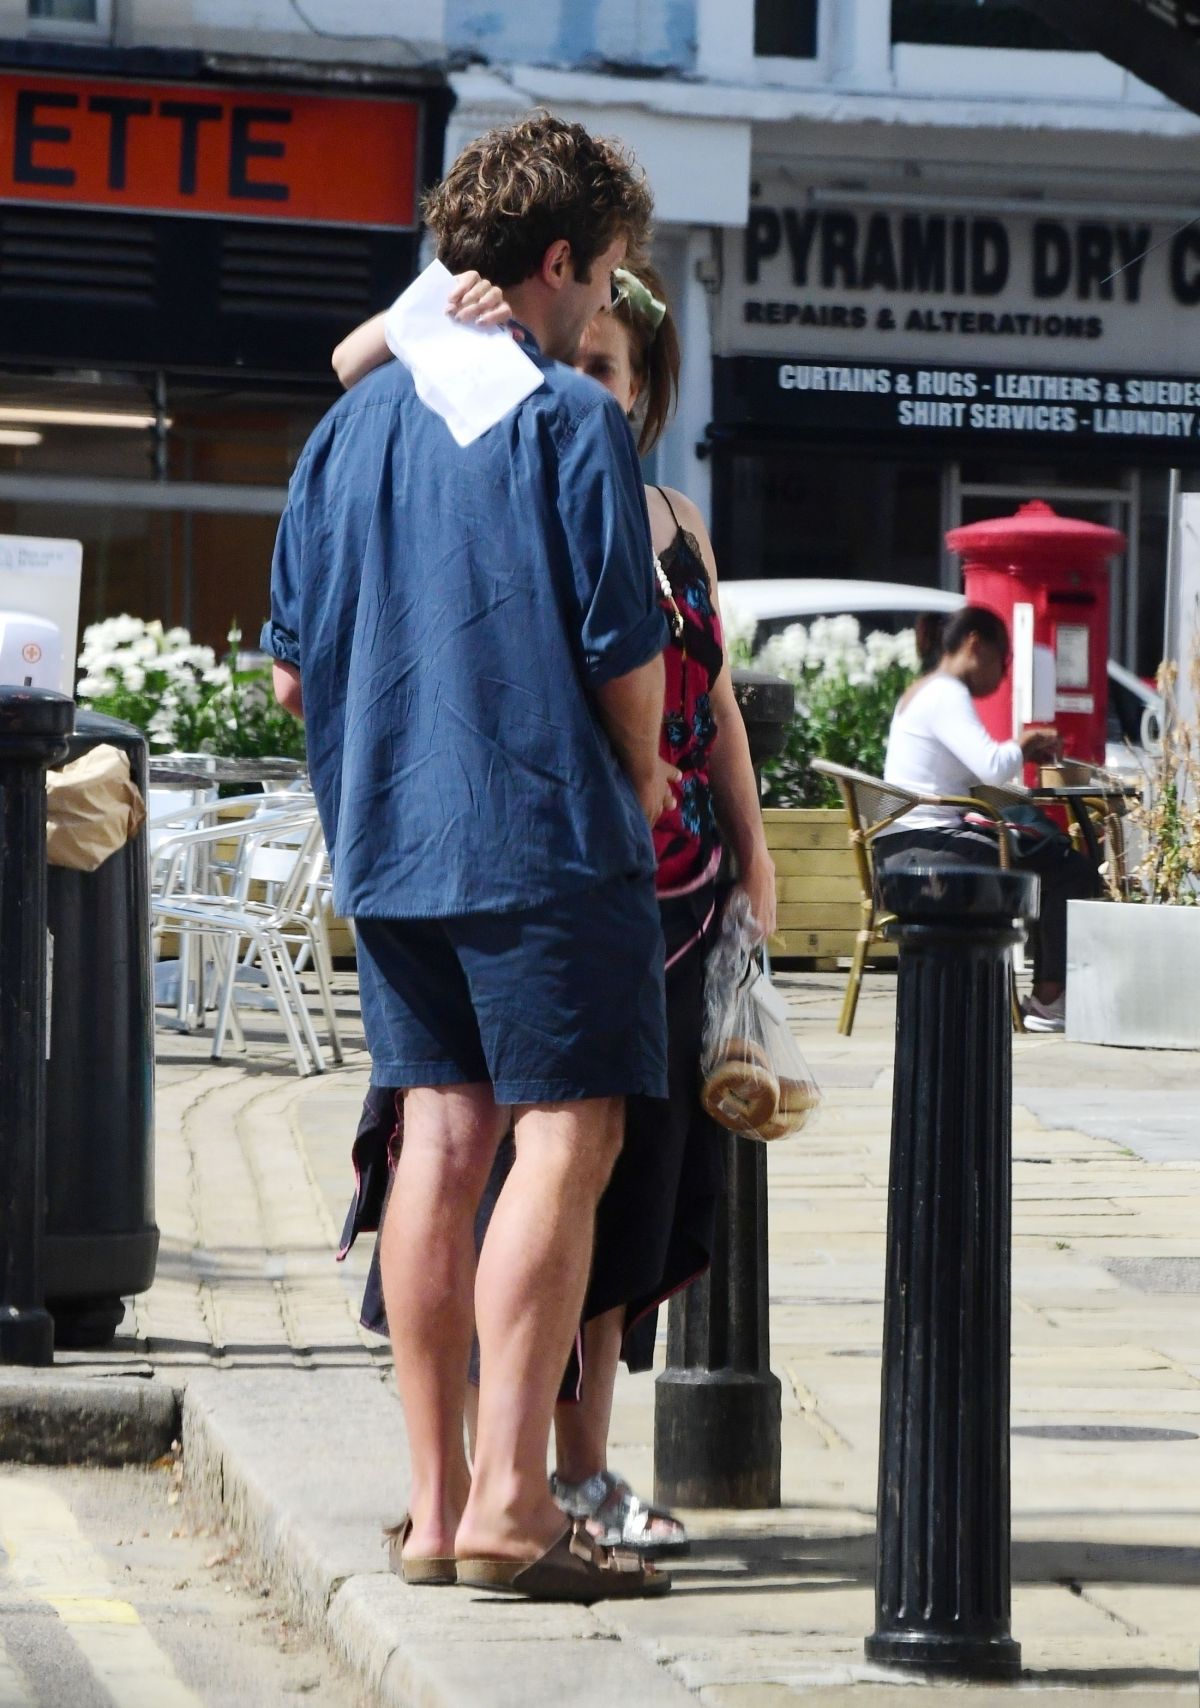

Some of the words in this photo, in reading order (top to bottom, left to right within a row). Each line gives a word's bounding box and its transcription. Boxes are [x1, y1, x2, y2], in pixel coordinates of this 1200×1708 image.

[13, 91, 293, 200] ETTE
[744, 207, 1010, 297] PYRAMID
[1032, 219, 1151, 303] DRY
[744, 301, 867, 330] REPAIRS
[876, 307, 896, 331] &
[905, 308, 1103, 339] ALTERATIONS
[778, 364, 892, 394] CURTAINS
[895, 373, 912, 395] &
[917, 371, 978, 397] RUGS
[995, 374, 1100, 401] LEATHERS
[1104, 379, 1121, 402] &
[898, 400, 966, 428] SHIRT
[970, 405, 1077, 433] SERVICES
[1094, 409, 1195, 438] LAUNDRY
